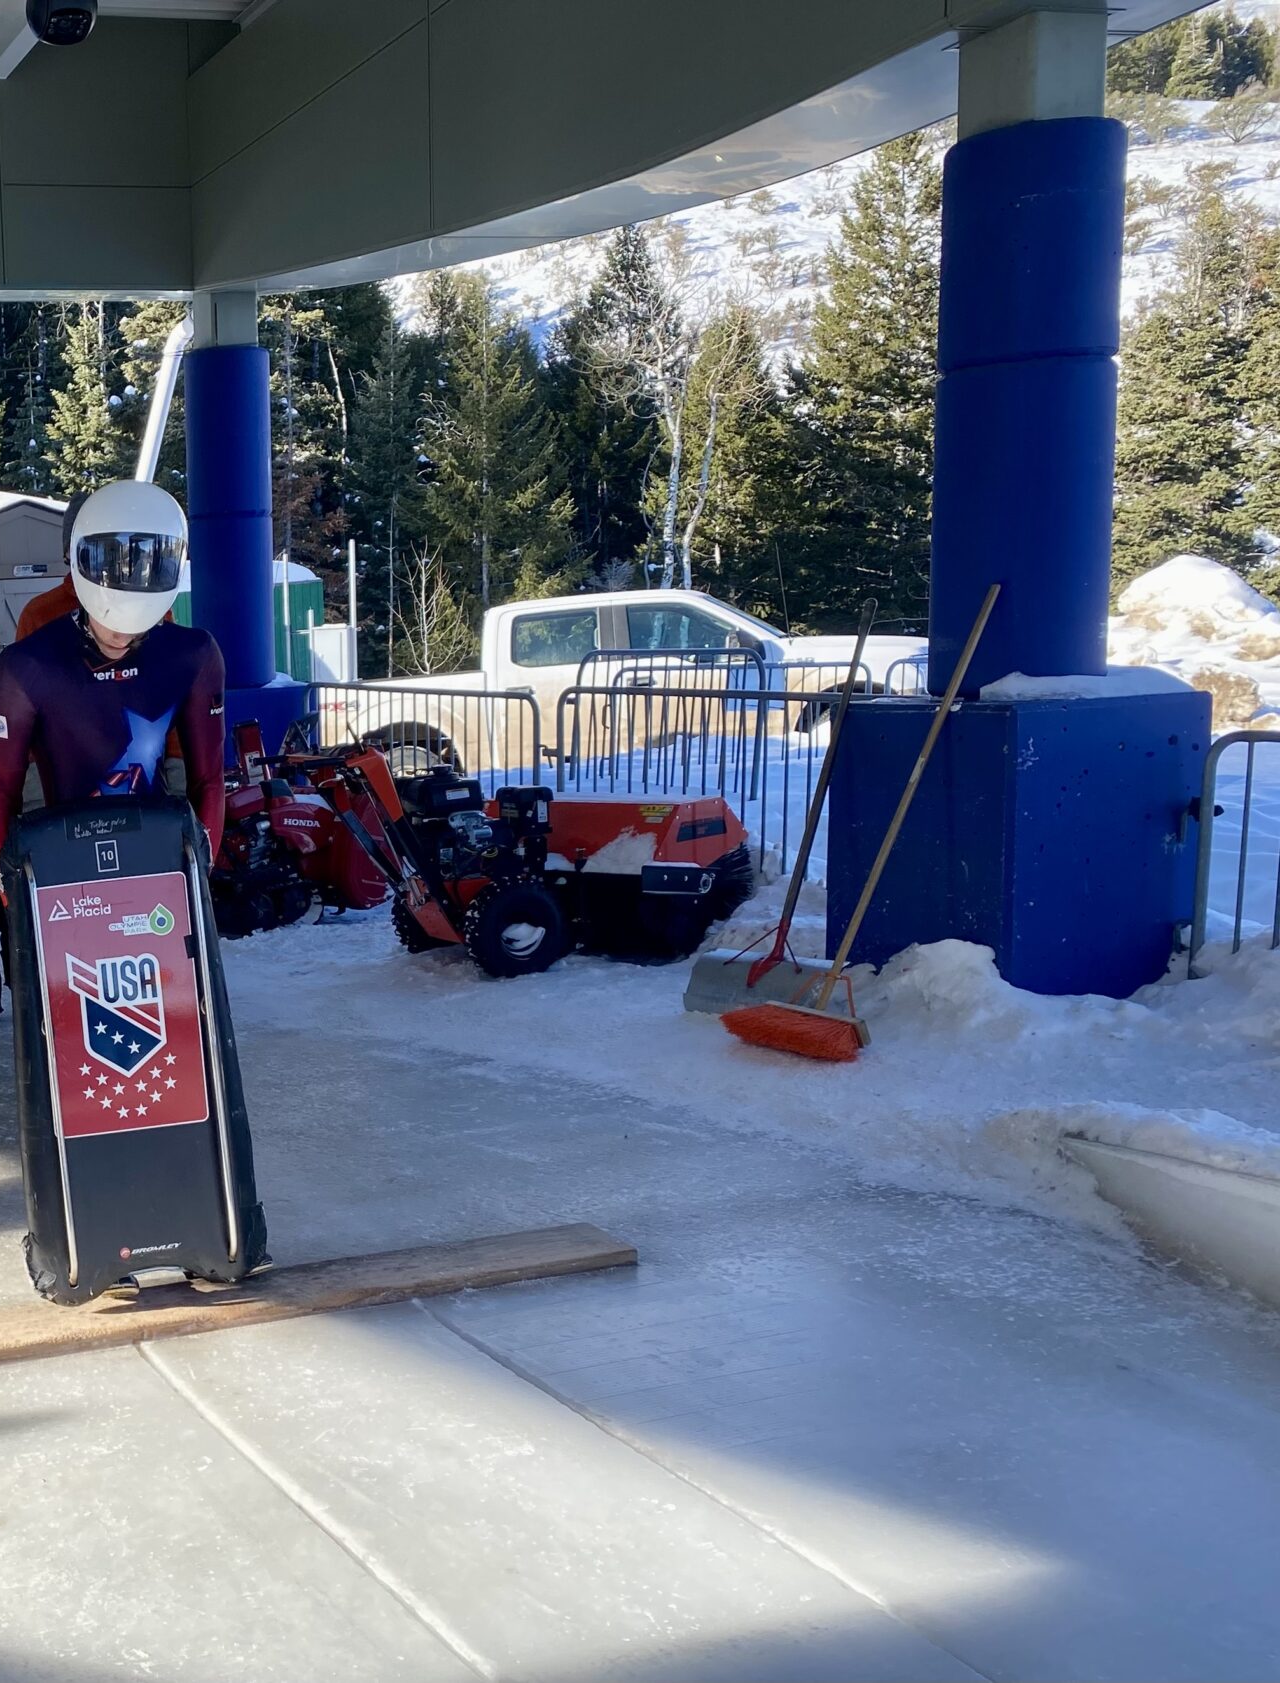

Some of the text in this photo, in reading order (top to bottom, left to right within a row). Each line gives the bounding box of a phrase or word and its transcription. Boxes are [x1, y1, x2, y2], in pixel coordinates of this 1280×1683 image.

[93, 667, 139, 681] verizon
[283, 818, 321, 828] HONDA
[101, 850, 114, 861] 10
[72, 895, 102, 908] Lake
[73, 904, 112, 918] Placid
[101, 958, 158, 1003] USA
[131, 1242, 182, 1255] BROMLEY
